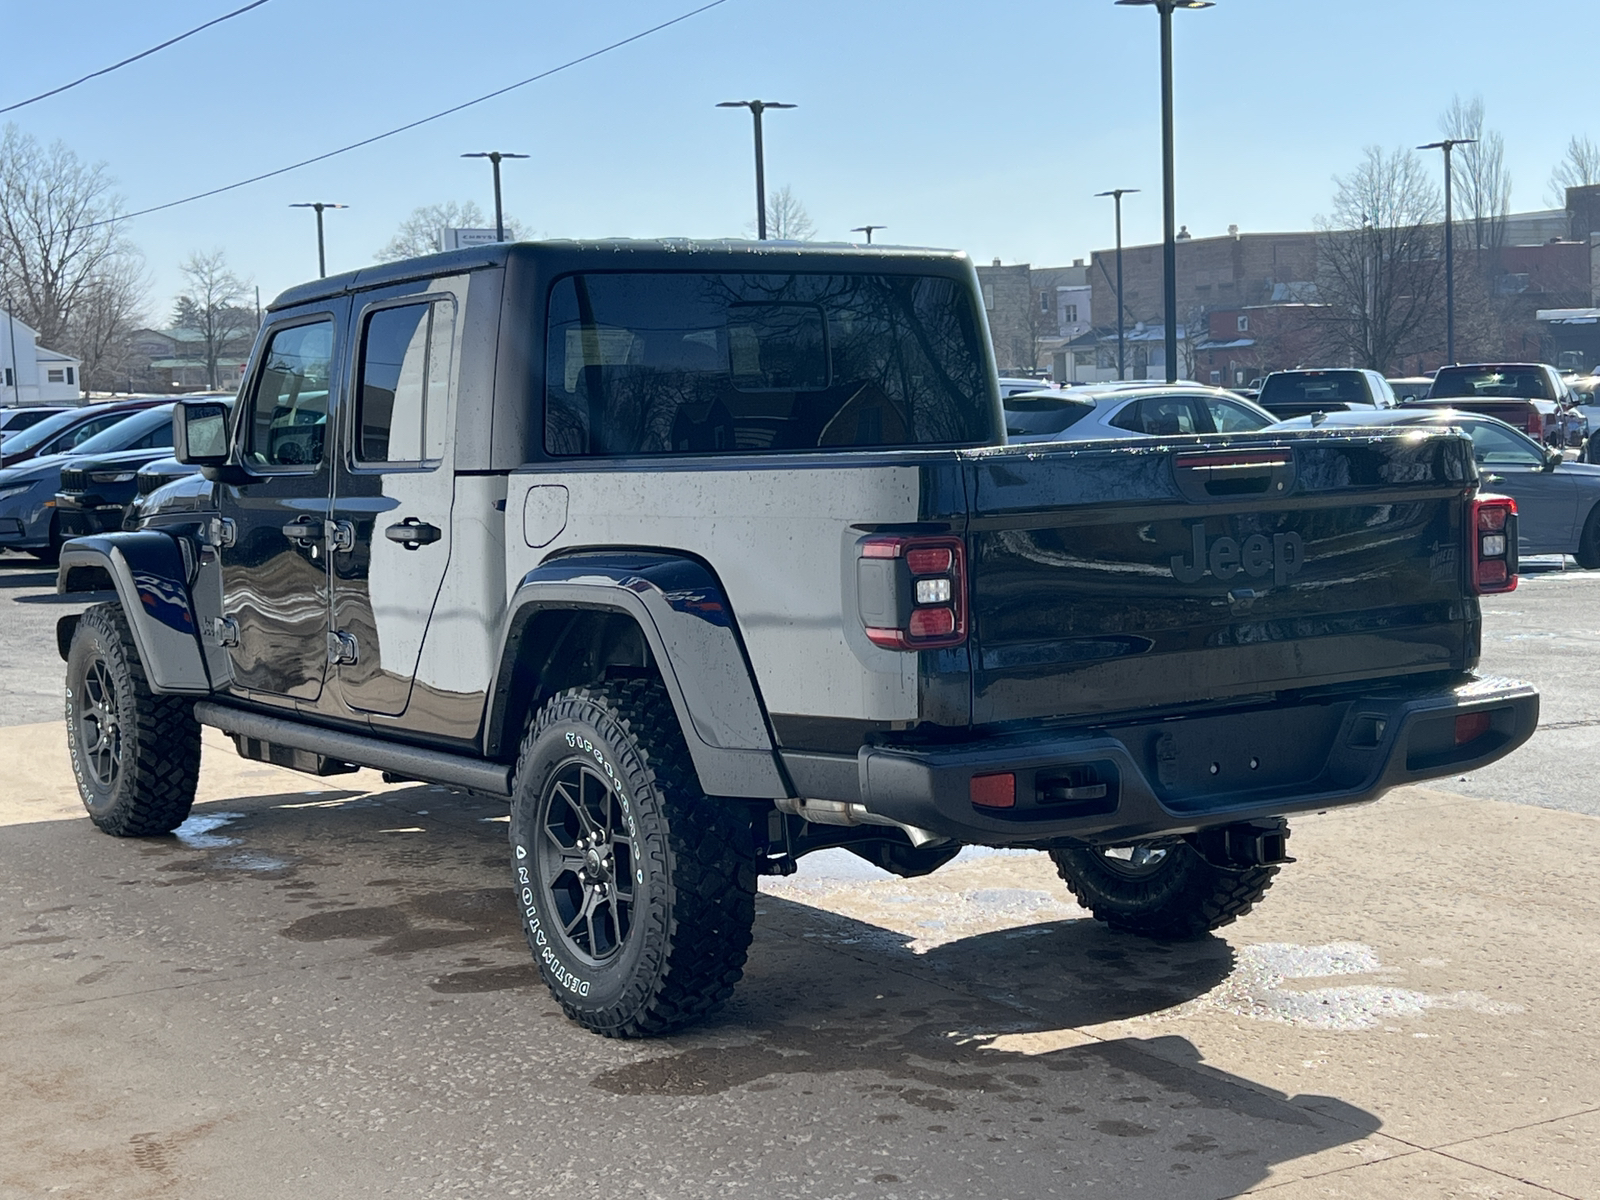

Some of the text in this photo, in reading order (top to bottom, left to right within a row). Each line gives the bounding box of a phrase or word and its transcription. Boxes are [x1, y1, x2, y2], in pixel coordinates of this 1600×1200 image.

[1170, 524, 1303, 586] Jeep
[1429, 548, 1455, 568] WHEEL
[517, 867, 591, 997] DESTINATION
